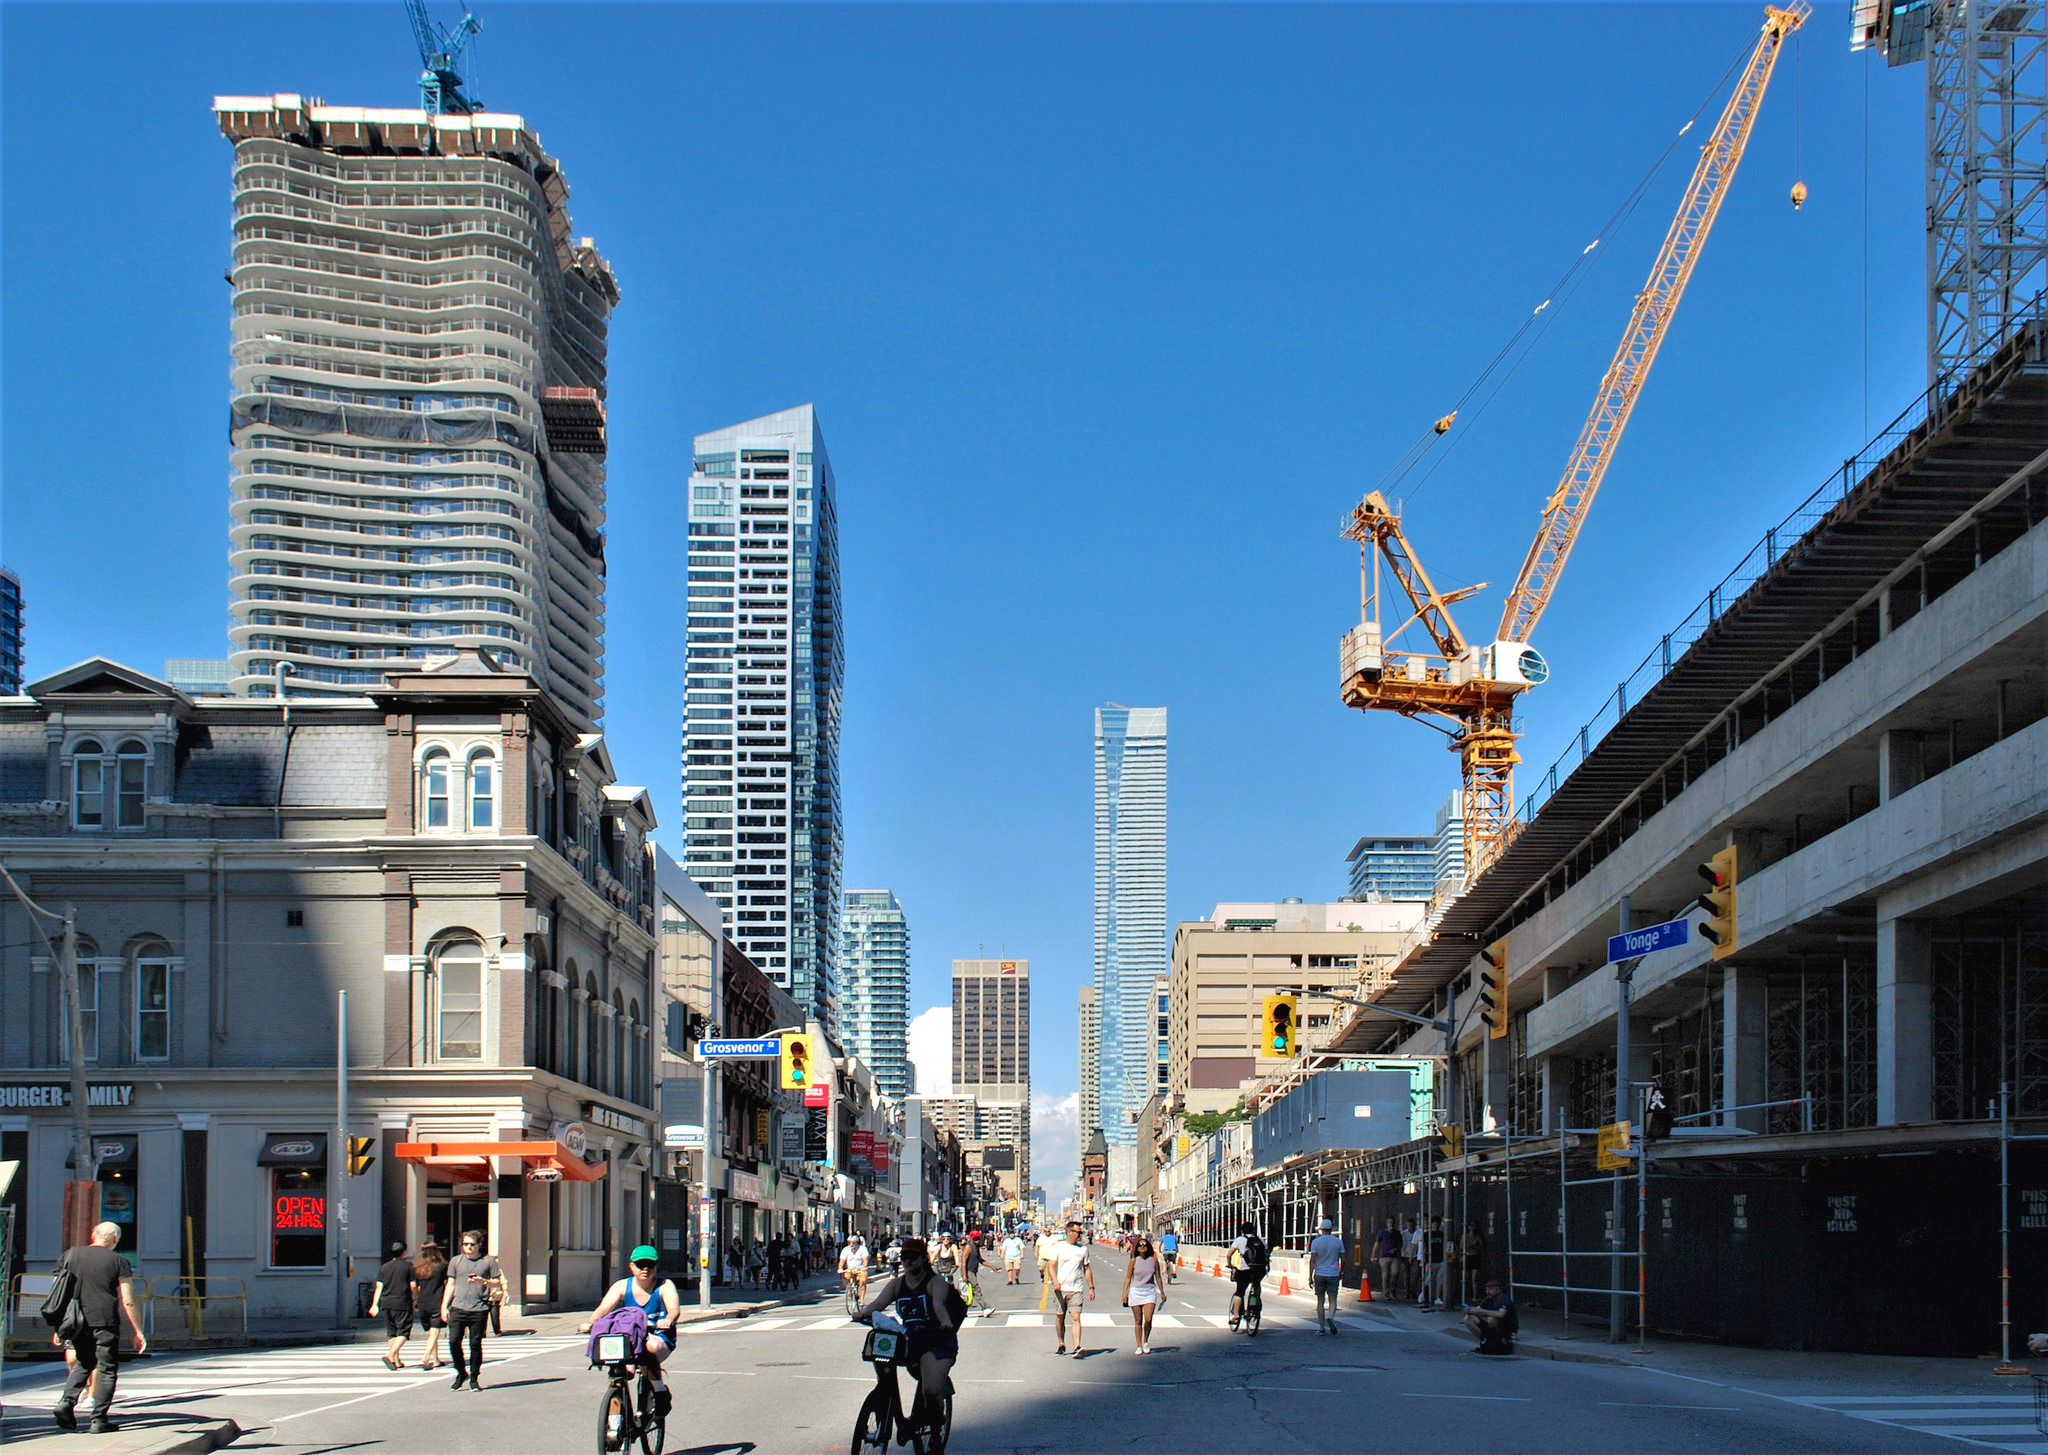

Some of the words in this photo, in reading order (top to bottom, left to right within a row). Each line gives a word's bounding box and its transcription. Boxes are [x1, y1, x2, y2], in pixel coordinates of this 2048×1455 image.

[1624, 931, 1660, 951] Yonge
[1663, 925, 1671, 934] St
[704, 1042, 764, 1054] Grosvenor
[767, 1041, 775, 1049] St
[87, 1085, 132, 1106] MILY
[814, 1108, 826, 1139] WAX
[666, 1133, 695, 1141] Grosvenor
[1827, 1195, 1857, 1208] POST
[2021, 1189, 2048, 1202] POS
[276, 1196, 325, 1215] OPEN
[2028, 1203, 2047, 1215] NO
[1833, 1208, 1852, 1220] NO
[276, 1214, 293, 1228] 24
[2020, 1215, 2048, 1228] BILL
